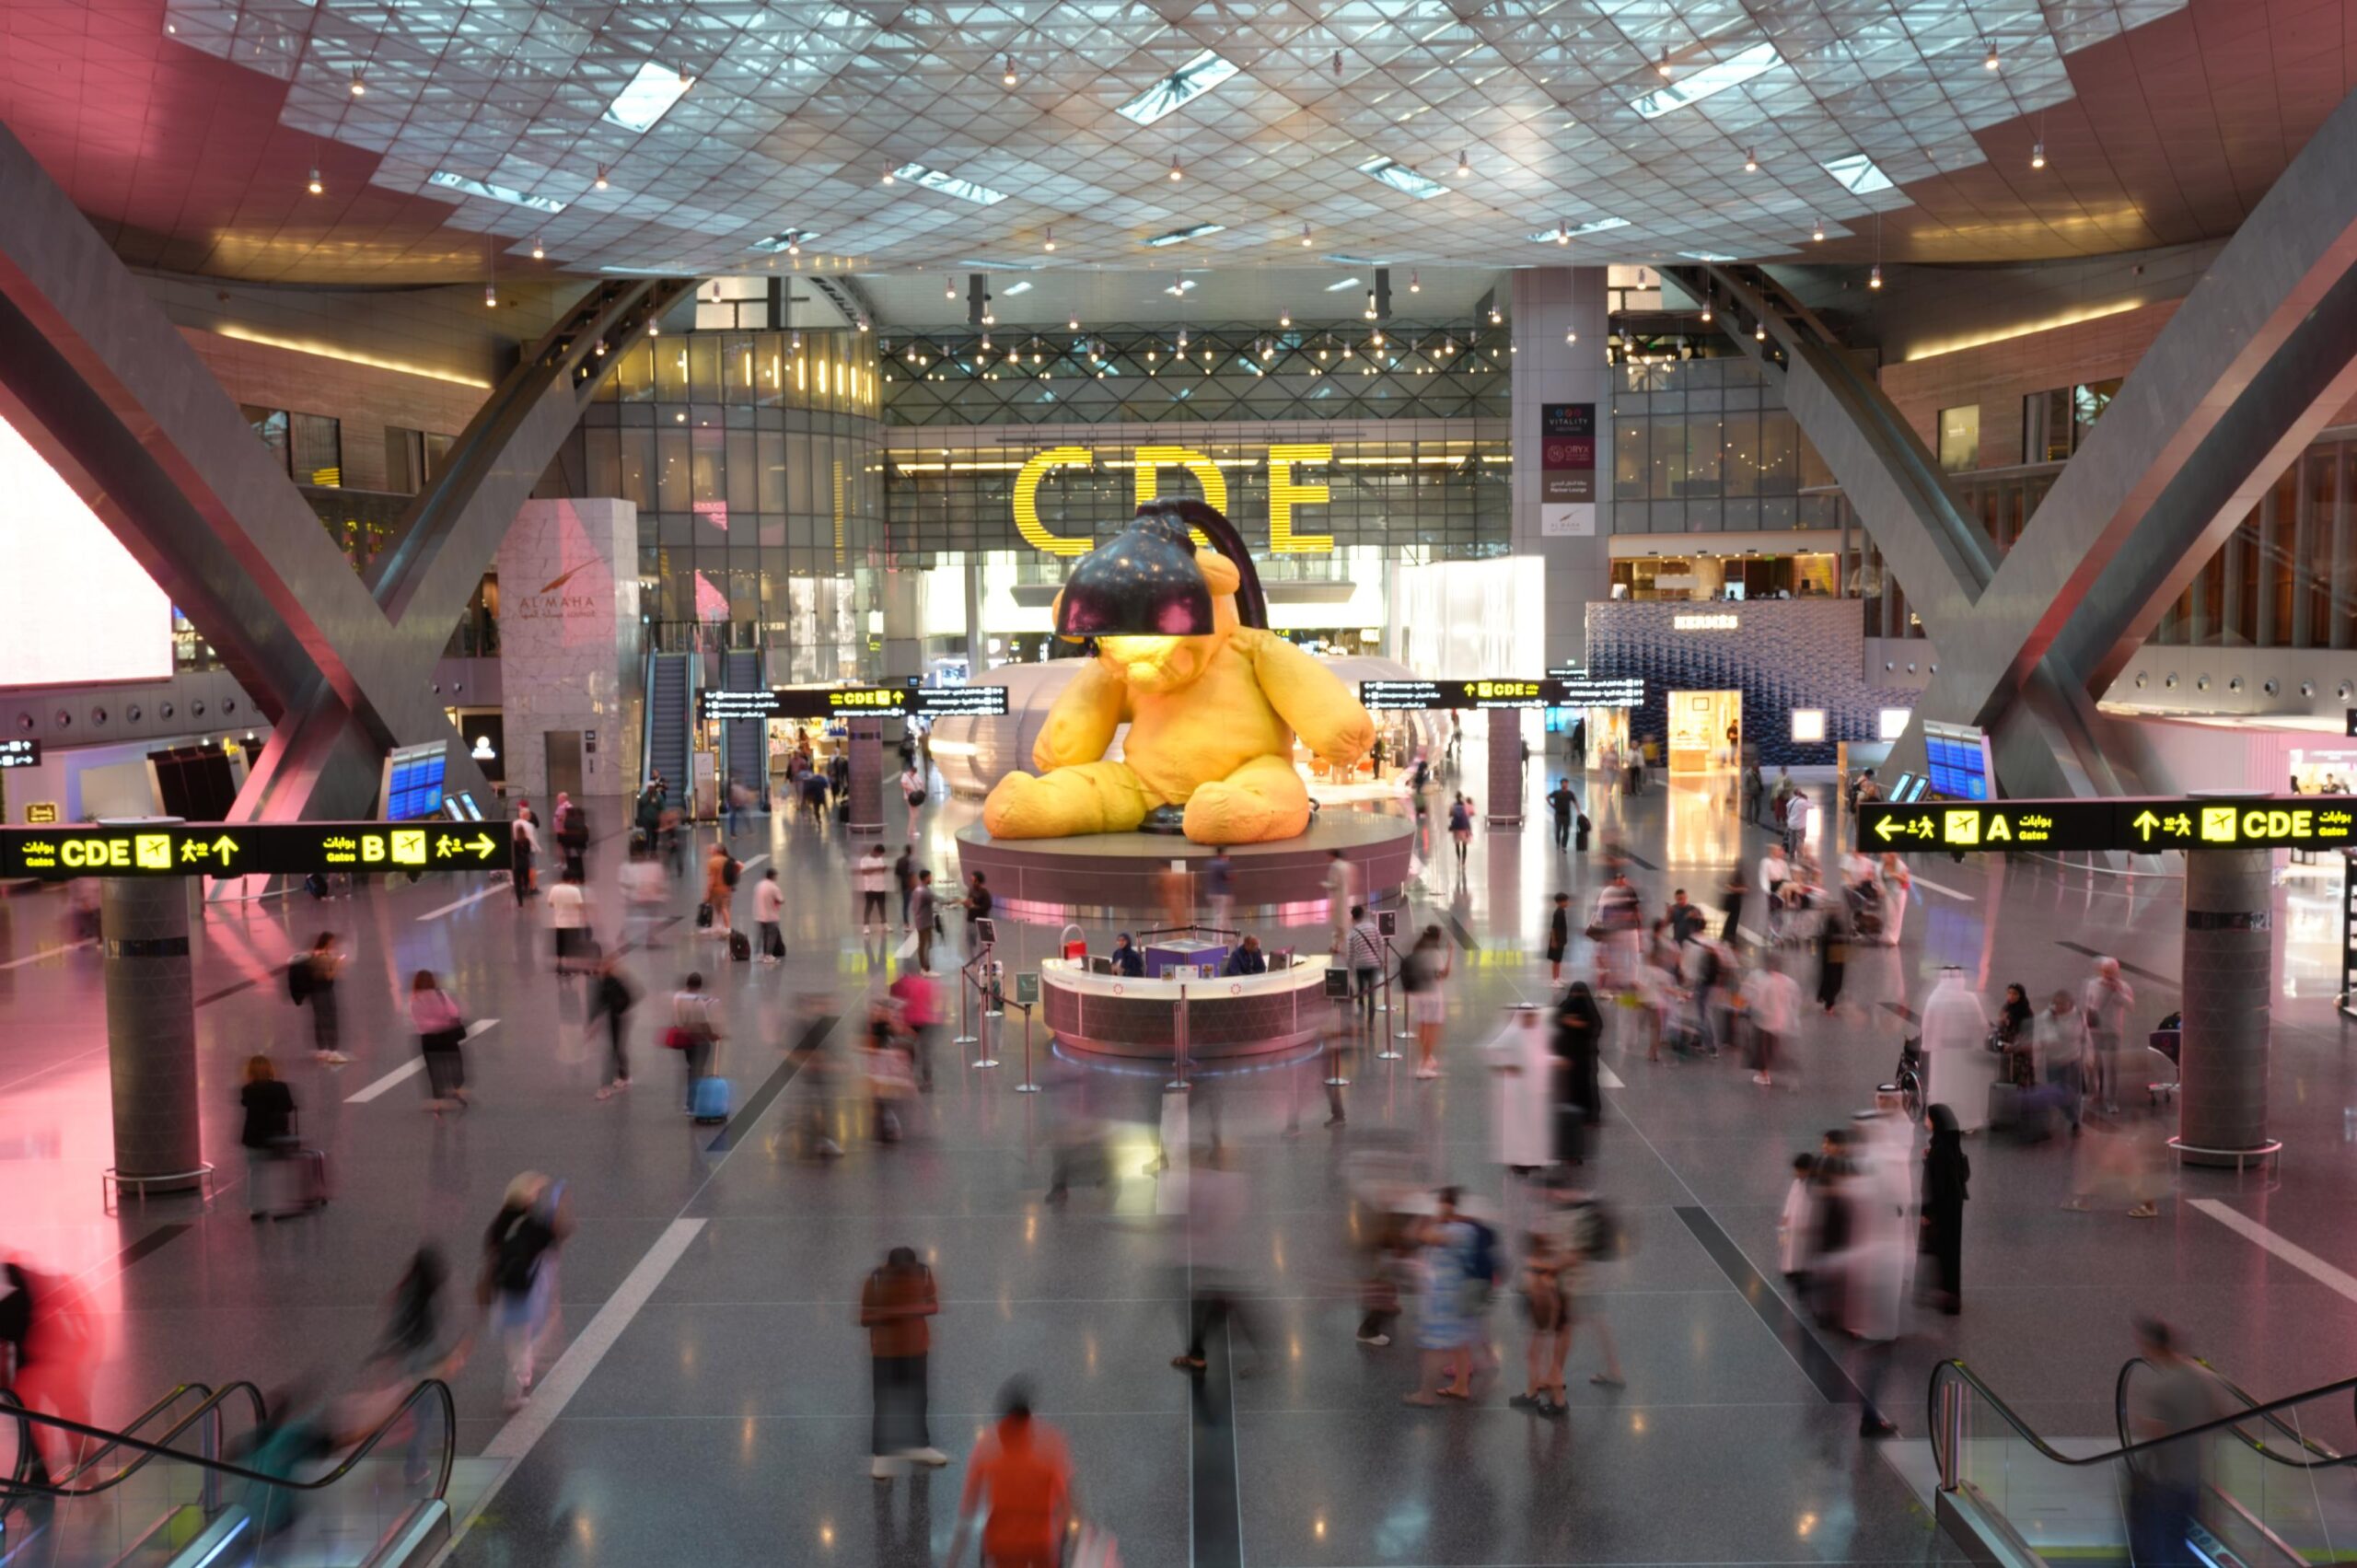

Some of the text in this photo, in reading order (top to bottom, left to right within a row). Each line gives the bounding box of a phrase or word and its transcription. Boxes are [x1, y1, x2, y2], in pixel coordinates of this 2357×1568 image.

[519, 597, 595, 609] AL MAHA
[1493, 683, 1525, 696] CDE
[843, 691, 875, 704] CDE
[1985, 814, 2013, 842] A
[2242, 810, 2313, 839] CDE
[2018, 830, 2049, 841] Gates
[2317, 826, 2349, 837] Gates
[60, 839, 132, 867] CDE
[361, 834, 386, 863] B
[25, 856, 56, 867] Gates
[326, 852, 356, 863] Gates
